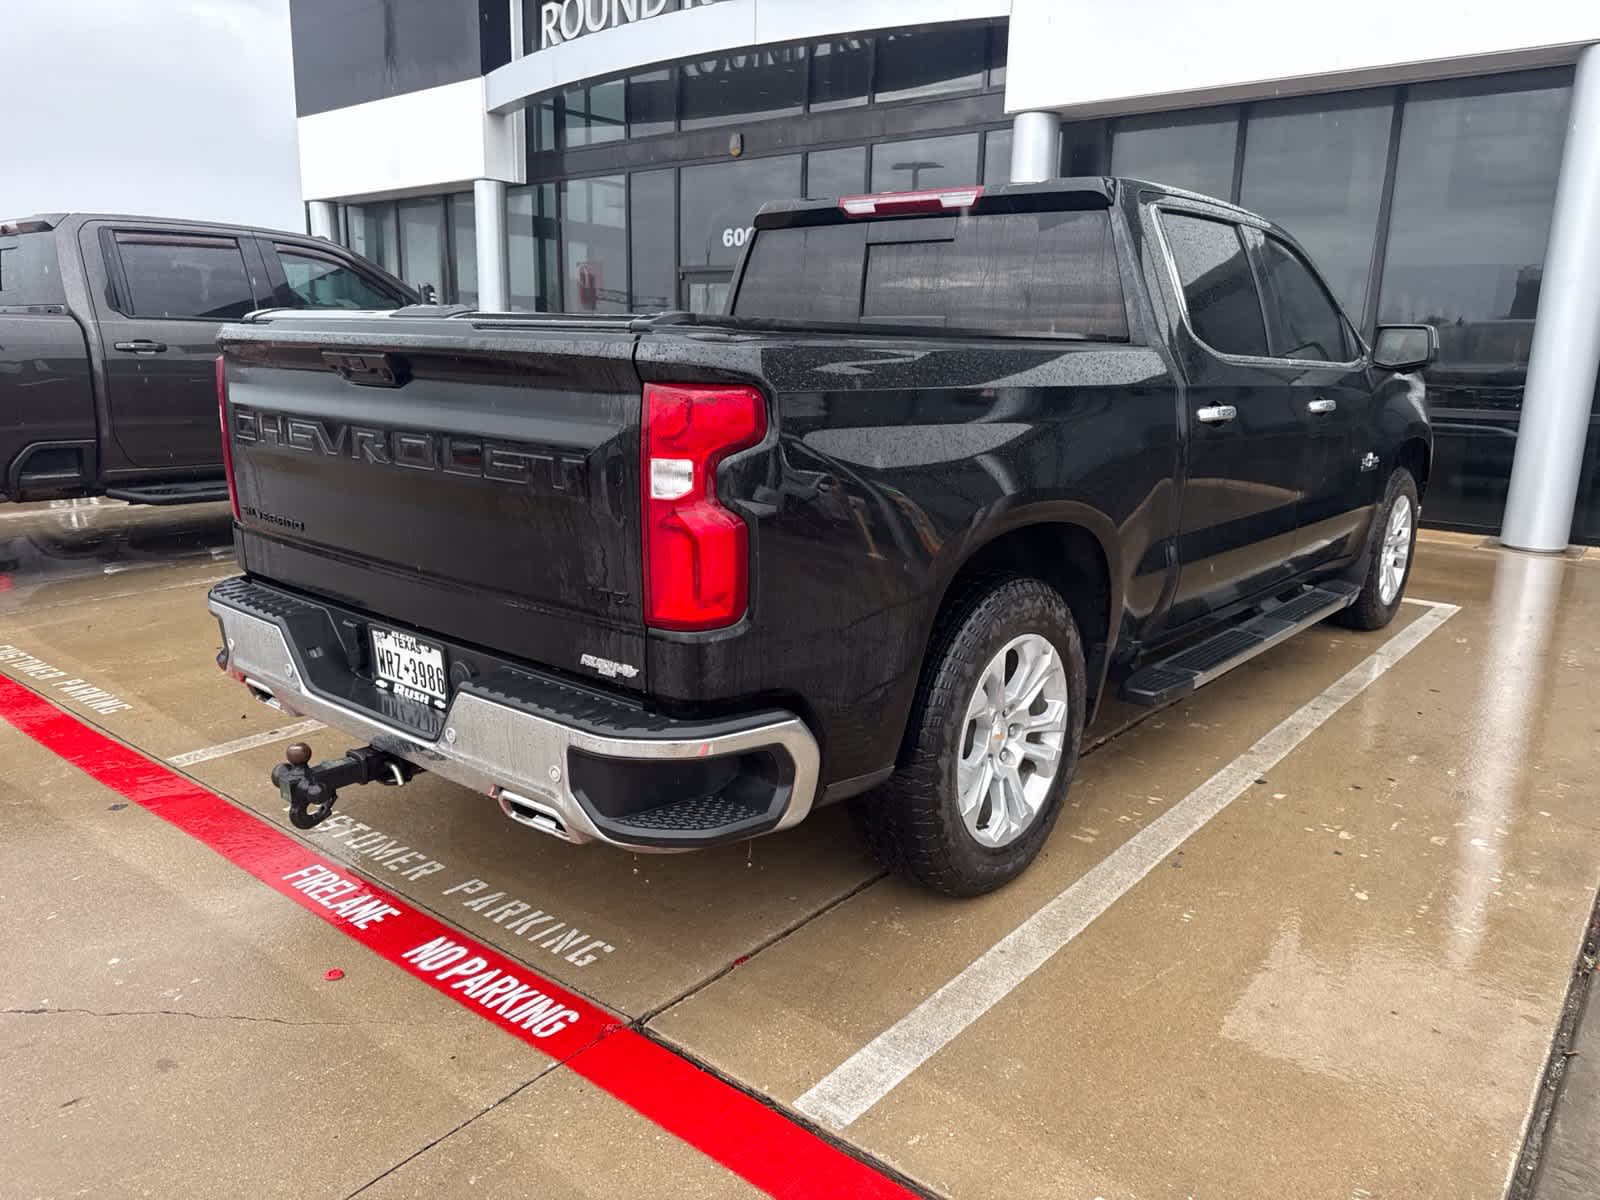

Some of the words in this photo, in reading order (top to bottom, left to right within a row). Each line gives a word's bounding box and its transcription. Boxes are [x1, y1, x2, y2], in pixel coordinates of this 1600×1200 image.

[233, 405, 587, 491] CHEVROLET
[392, 636, 422, 655] TEXAS
[51, 678, 133, 715] PARKING
[393, 682, 430, 705] RUSH
[283, 805, 446, 881] STOMER
[442, 878, 617, 967] PARKING
[401, 935, 469, 971] NO
[435, 957, 580, 1038] PARKING
